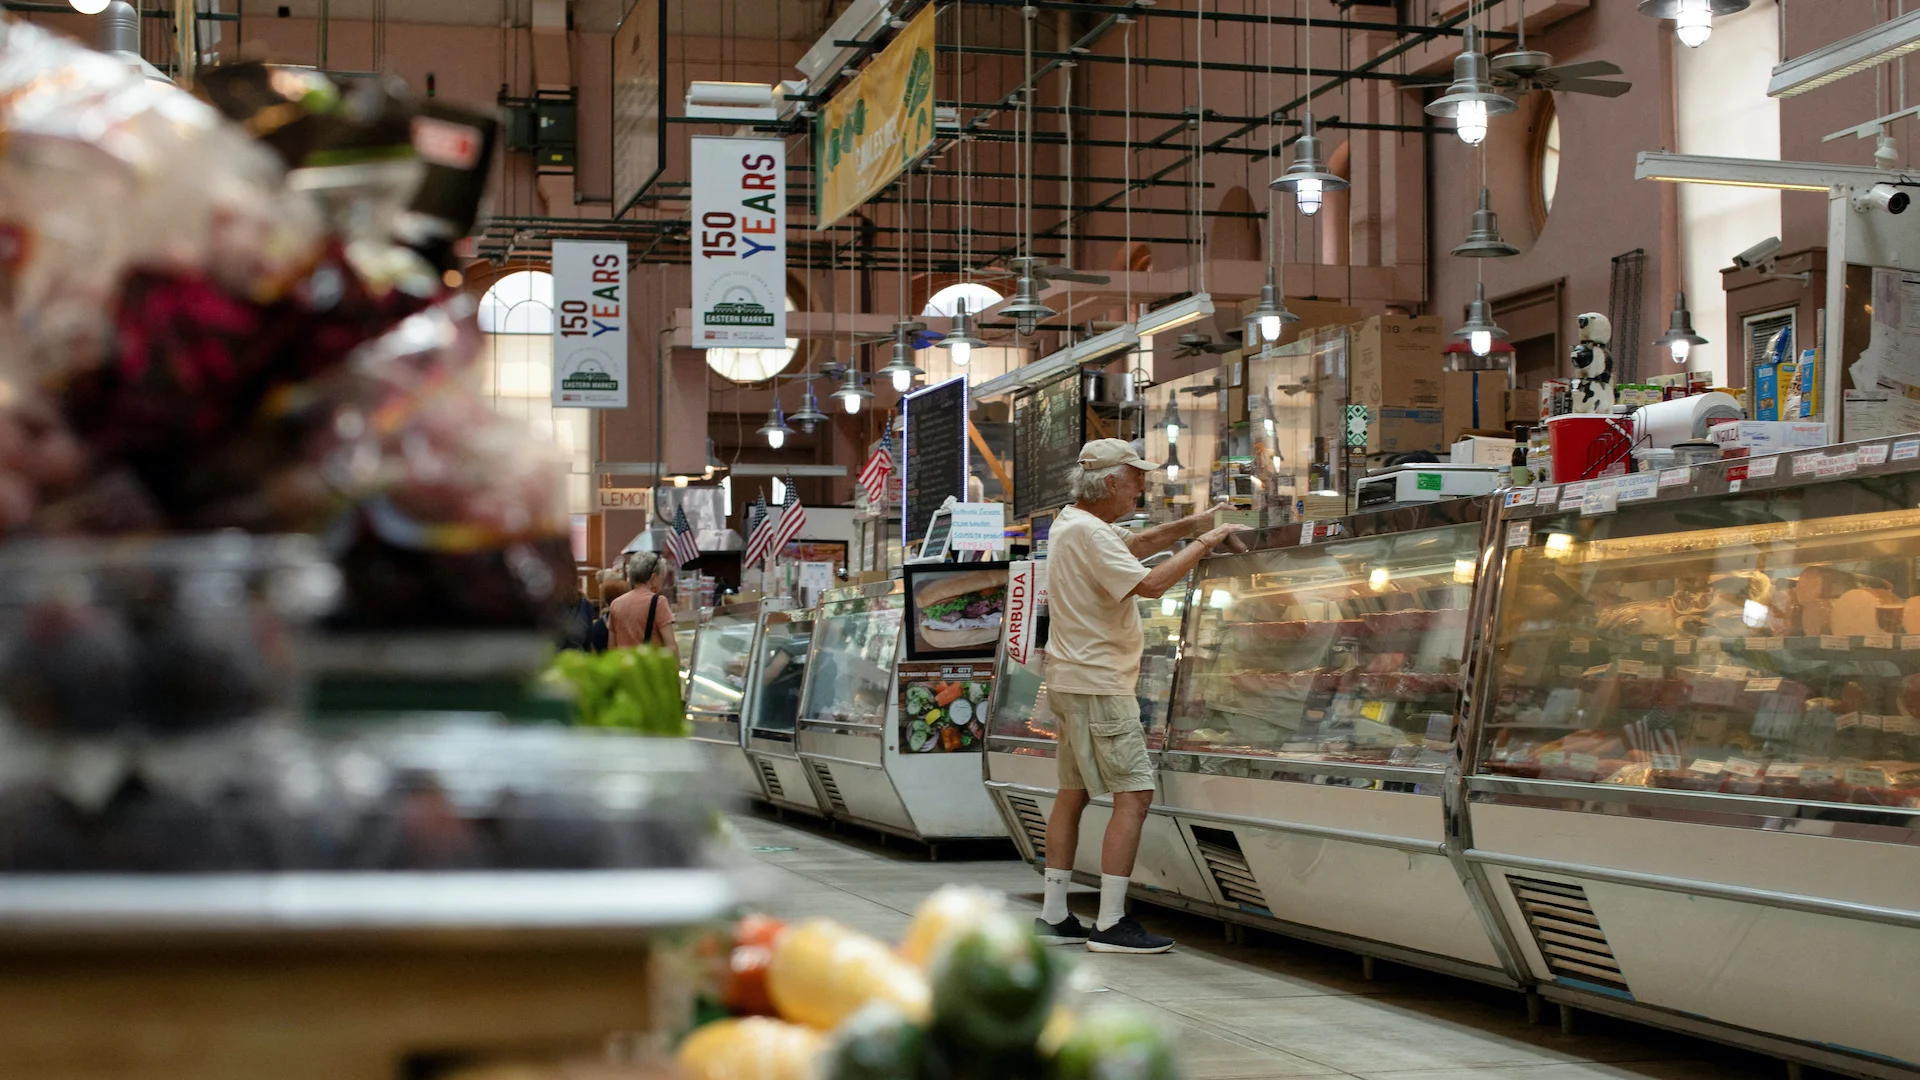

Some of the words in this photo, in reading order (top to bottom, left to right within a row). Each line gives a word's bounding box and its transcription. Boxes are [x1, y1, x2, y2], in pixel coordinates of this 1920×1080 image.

[741, 153, 776, 260] YEARS
[702, 211, 736, 259] 150
[560, 300, 588, 338] 150
[592, 254, 620, 338] YEARS
[705, 314, 740, 323] EASTERN
[741, 315, 773, 324] MARKET
[563, 381, 591, 389] EASTERN
[592, 381, 617, 389] MARKET
[1009, 572, 1026, 658] BARBUDA
